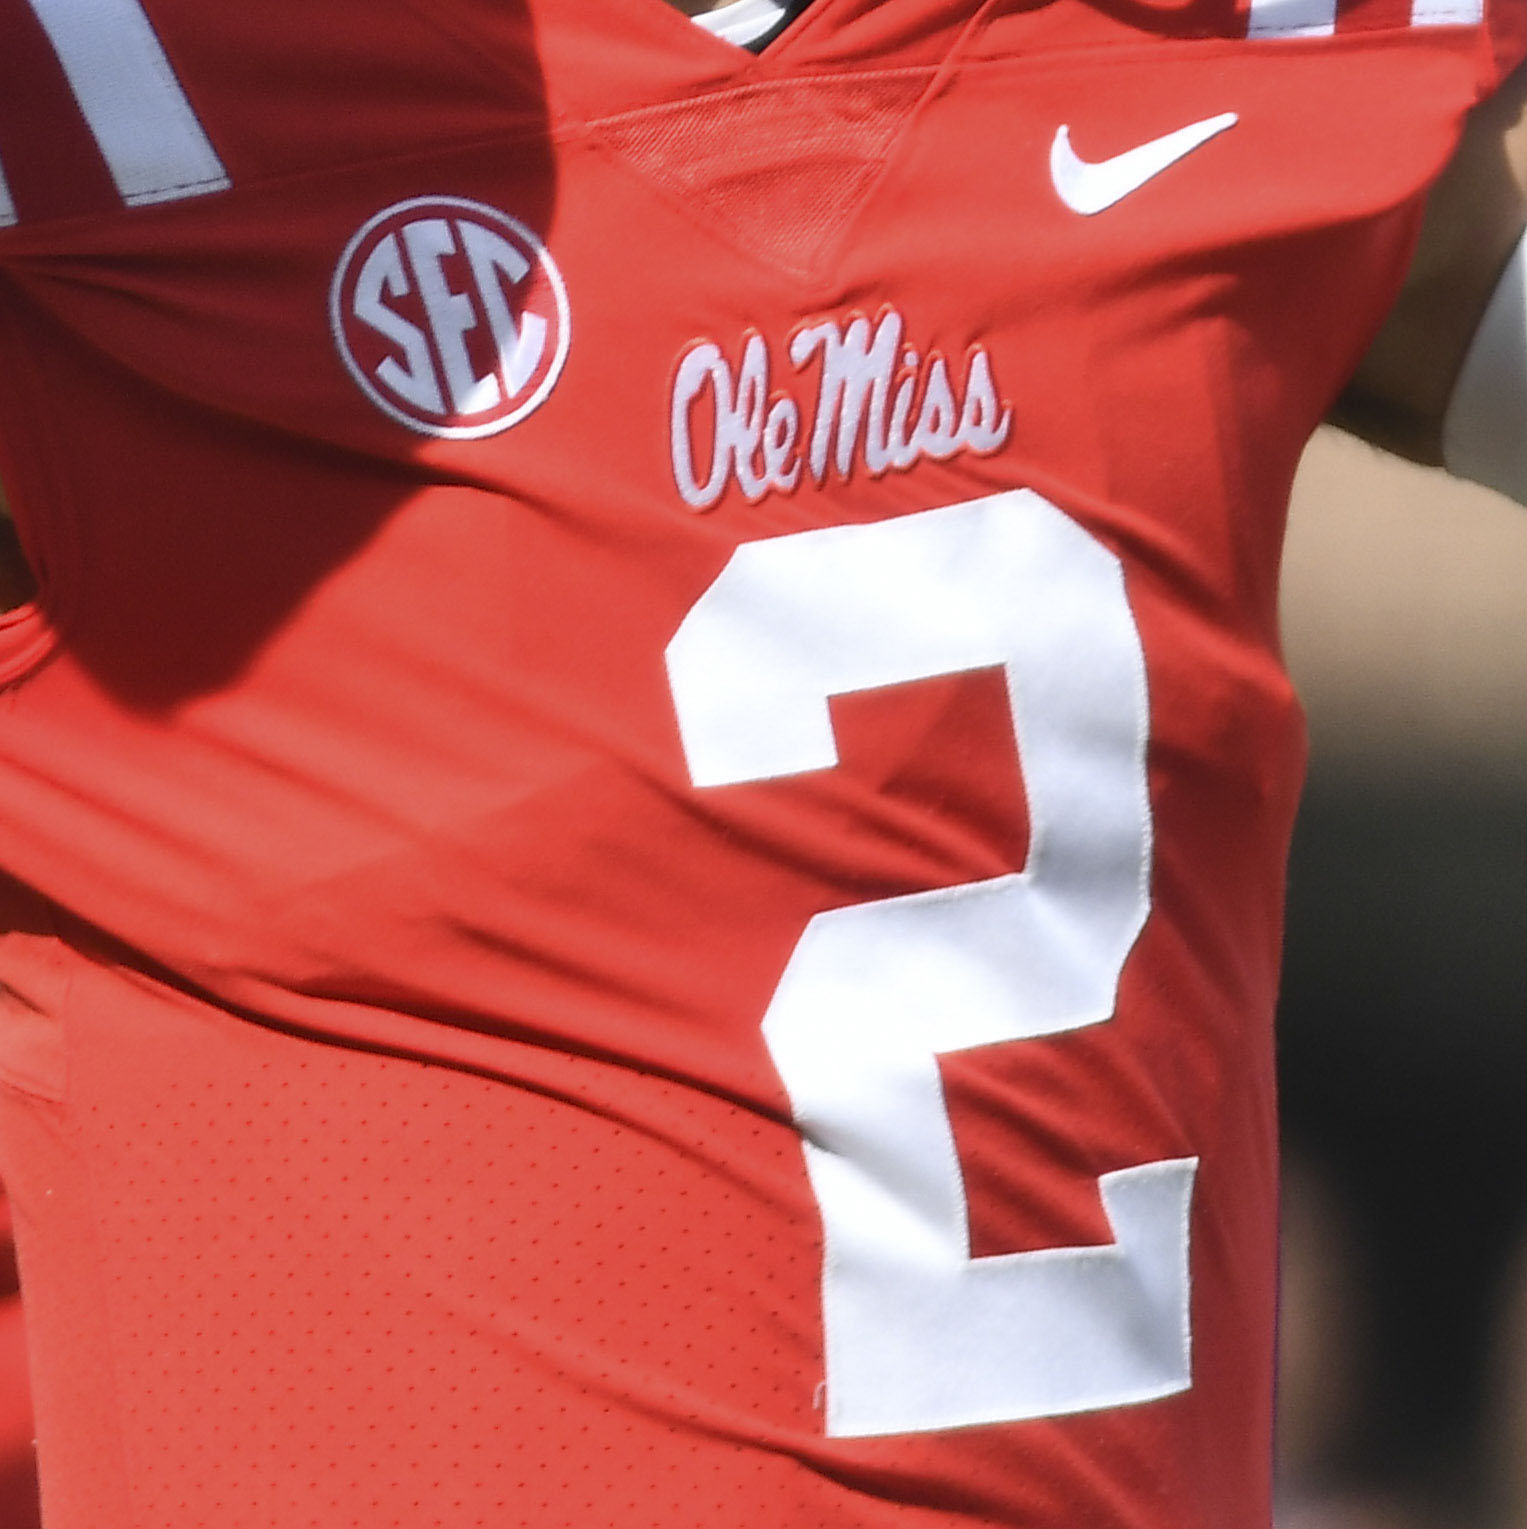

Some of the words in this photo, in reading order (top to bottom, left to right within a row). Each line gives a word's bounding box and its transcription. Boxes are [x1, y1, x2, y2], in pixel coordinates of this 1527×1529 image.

[349, 215, 550, 417] SEC
[668, 330, 804, 511] Ole
[786, 304, 1012, 482] Miss
[664, 486, 1199, 1440] 2
